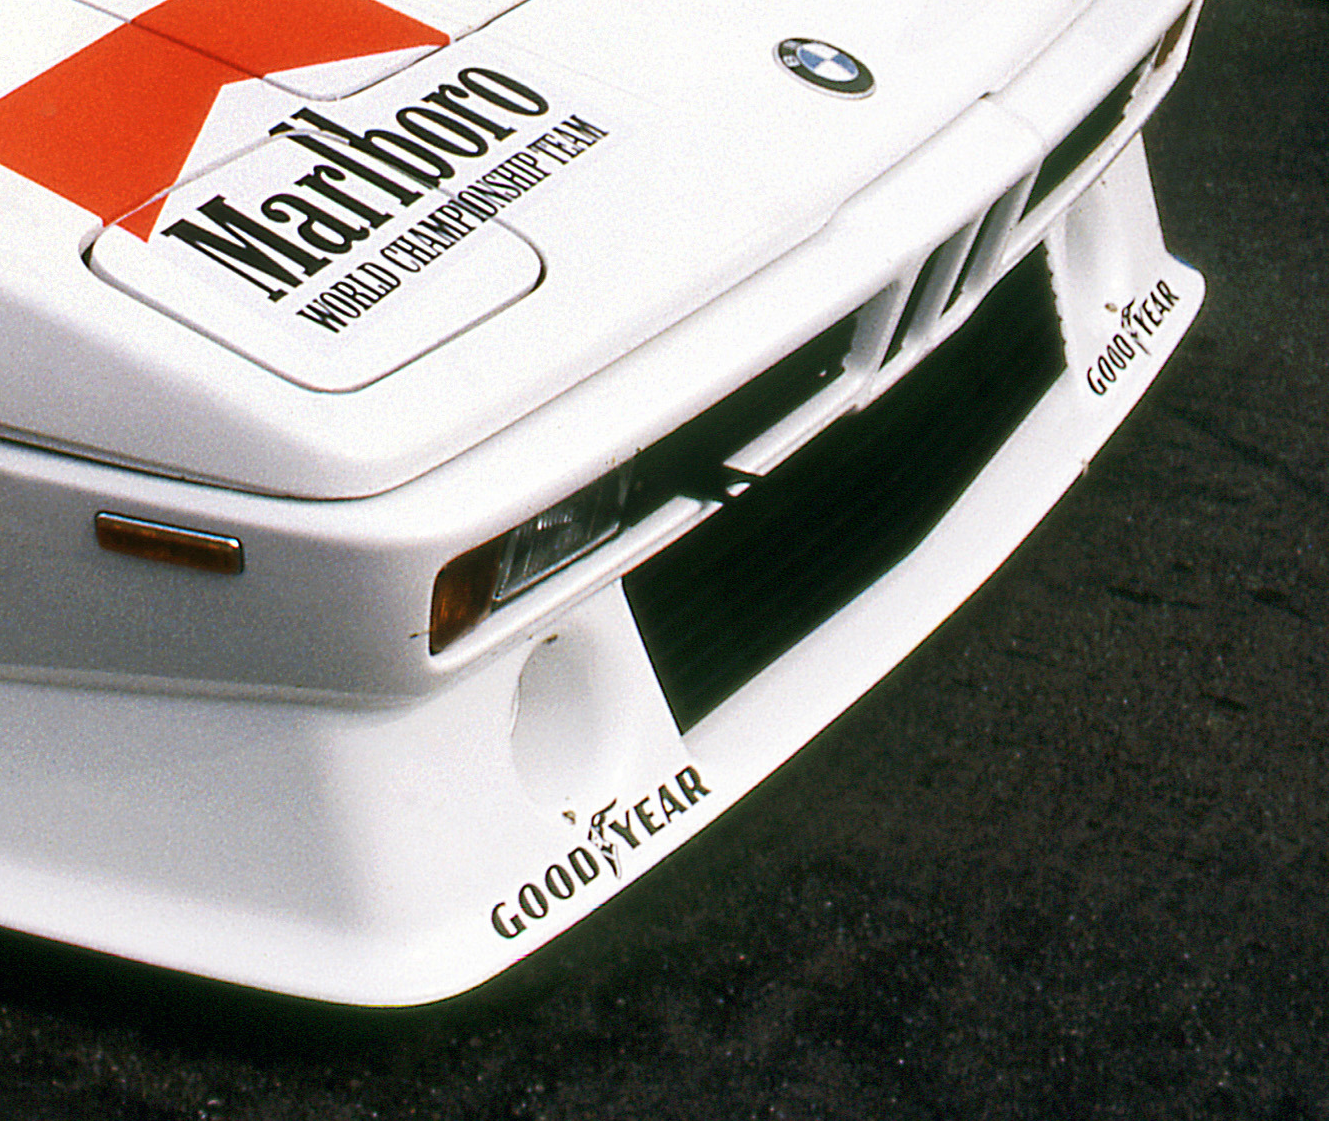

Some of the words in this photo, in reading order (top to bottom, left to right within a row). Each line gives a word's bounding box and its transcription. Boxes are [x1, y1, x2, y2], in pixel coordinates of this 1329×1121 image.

[160, 66, 551, 304] Marlboro
[295, 262, 403, 334] WORLD
[379, 150, 553, 274] CHAMPIONSHIP
[525, 114, 611, 166] TEAM
